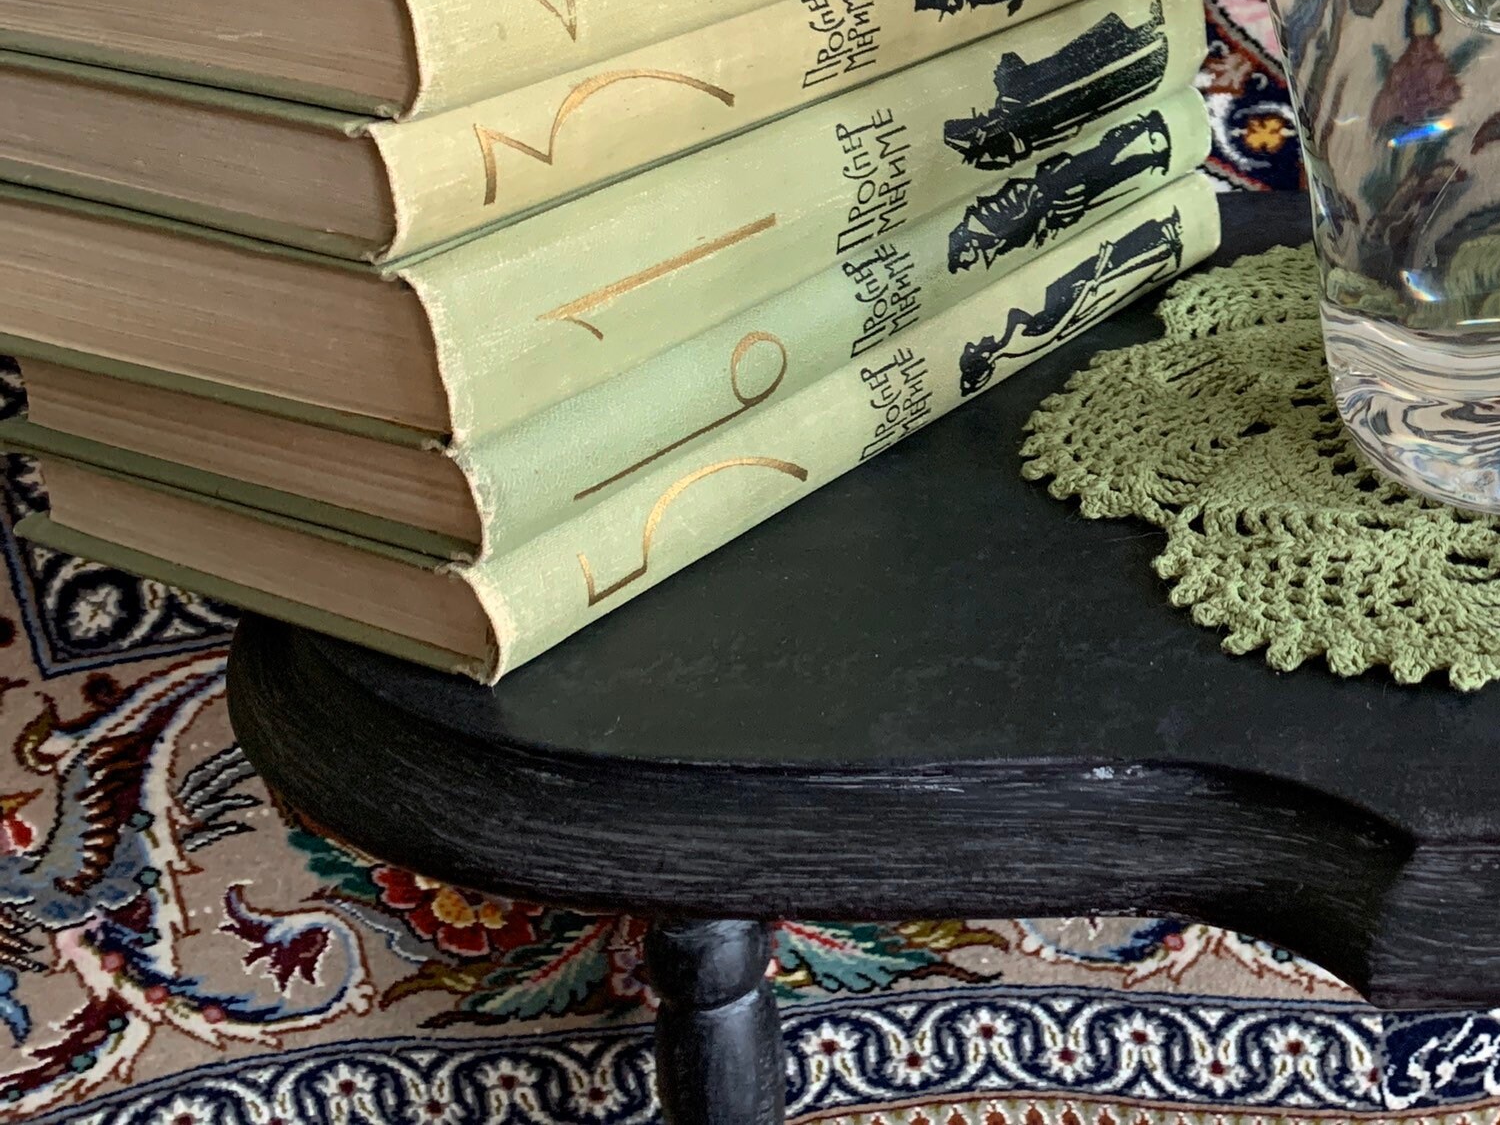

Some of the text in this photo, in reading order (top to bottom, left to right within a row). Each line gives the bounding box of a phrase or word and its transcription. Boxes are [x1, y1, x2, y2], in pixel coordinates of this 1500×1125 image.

[835, 122, 888, 256] ПРОСПЕР
[870, 107, 913, 236] МЕРИМЕ
[536, 212, 777, 342] 1
[841, 261, 898, 359] ПРОСПЕР
[874, 242, 922, 337] МЕРИМЕ
[858, 366, 908, 462] ПРОСПЕР
[892, 346, 934, 439] МЕРИМЕ
[576, 455, 809, 608] 5
